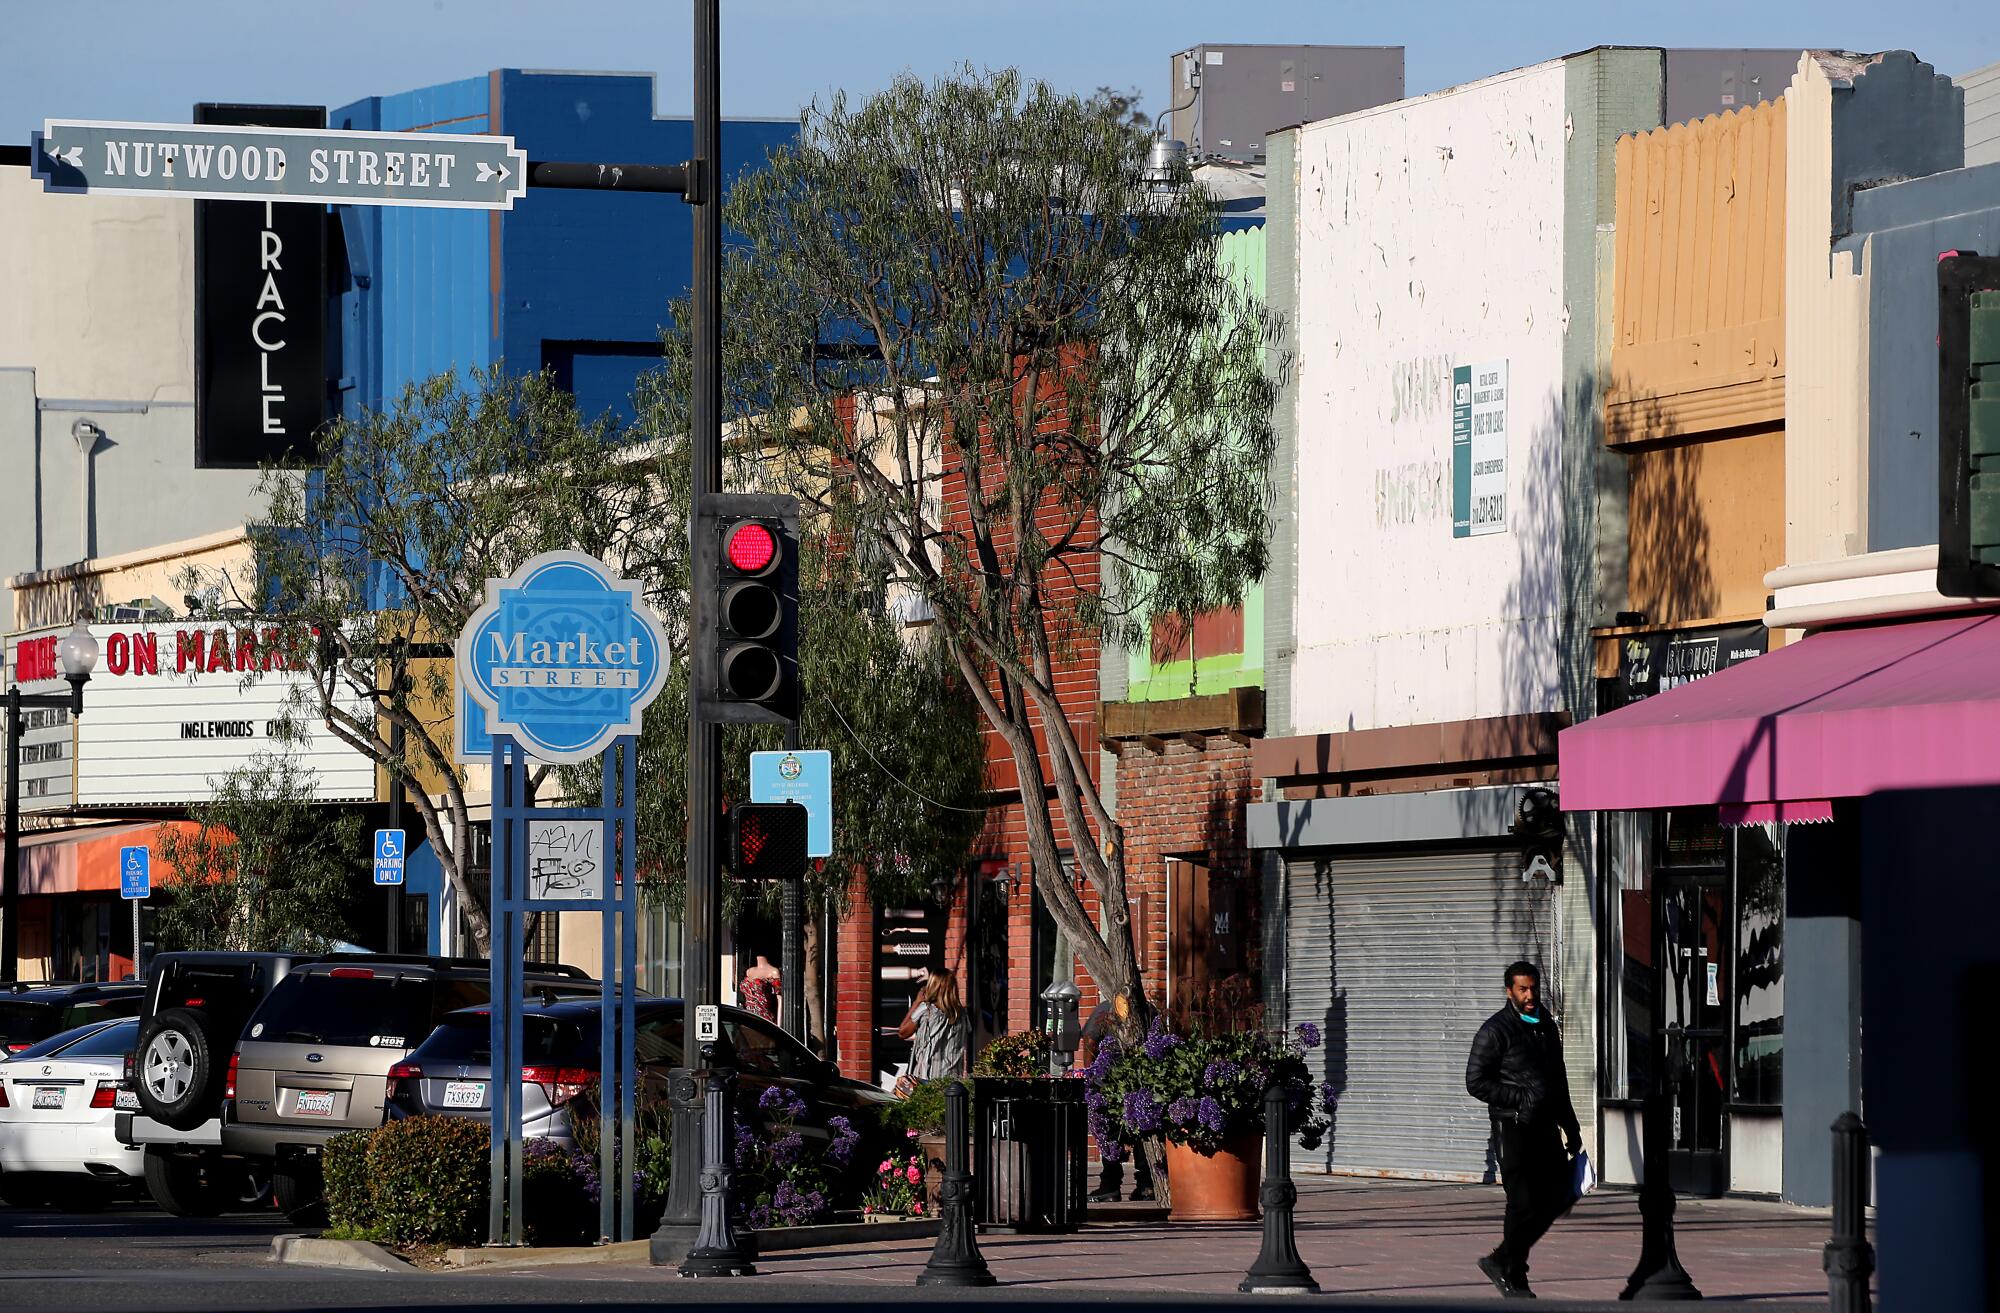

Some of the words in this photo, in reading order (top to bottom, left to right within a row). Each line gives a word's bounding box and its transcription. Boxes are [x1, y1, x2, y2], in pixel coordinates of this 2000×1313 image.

[104, 140, 287, 182] NUTWOOD
[309, 148, 457, 189] STREET
[252, 201, 286, 434] IRACLE
[1473, 412, 1485, 437] SPACE
[1492, 409, 1504, 434] LEASE
[1479, 494, 1503, 524] 231-5213
[107, 631, 158, 676] ON
[487, 631, 644, 666] Market
[499, 670, 632, 687] STREET
[180, 720, 254, 739] INGLEWOODS
[375, 857, 402, 869] PARKING
[379, 869, 398, 881] ONLY
[1214, 911, 1229, 935] 244
[380, 1038, 405, 1046] MOM
[447, 1091, 481, 1104] 7XSK939
